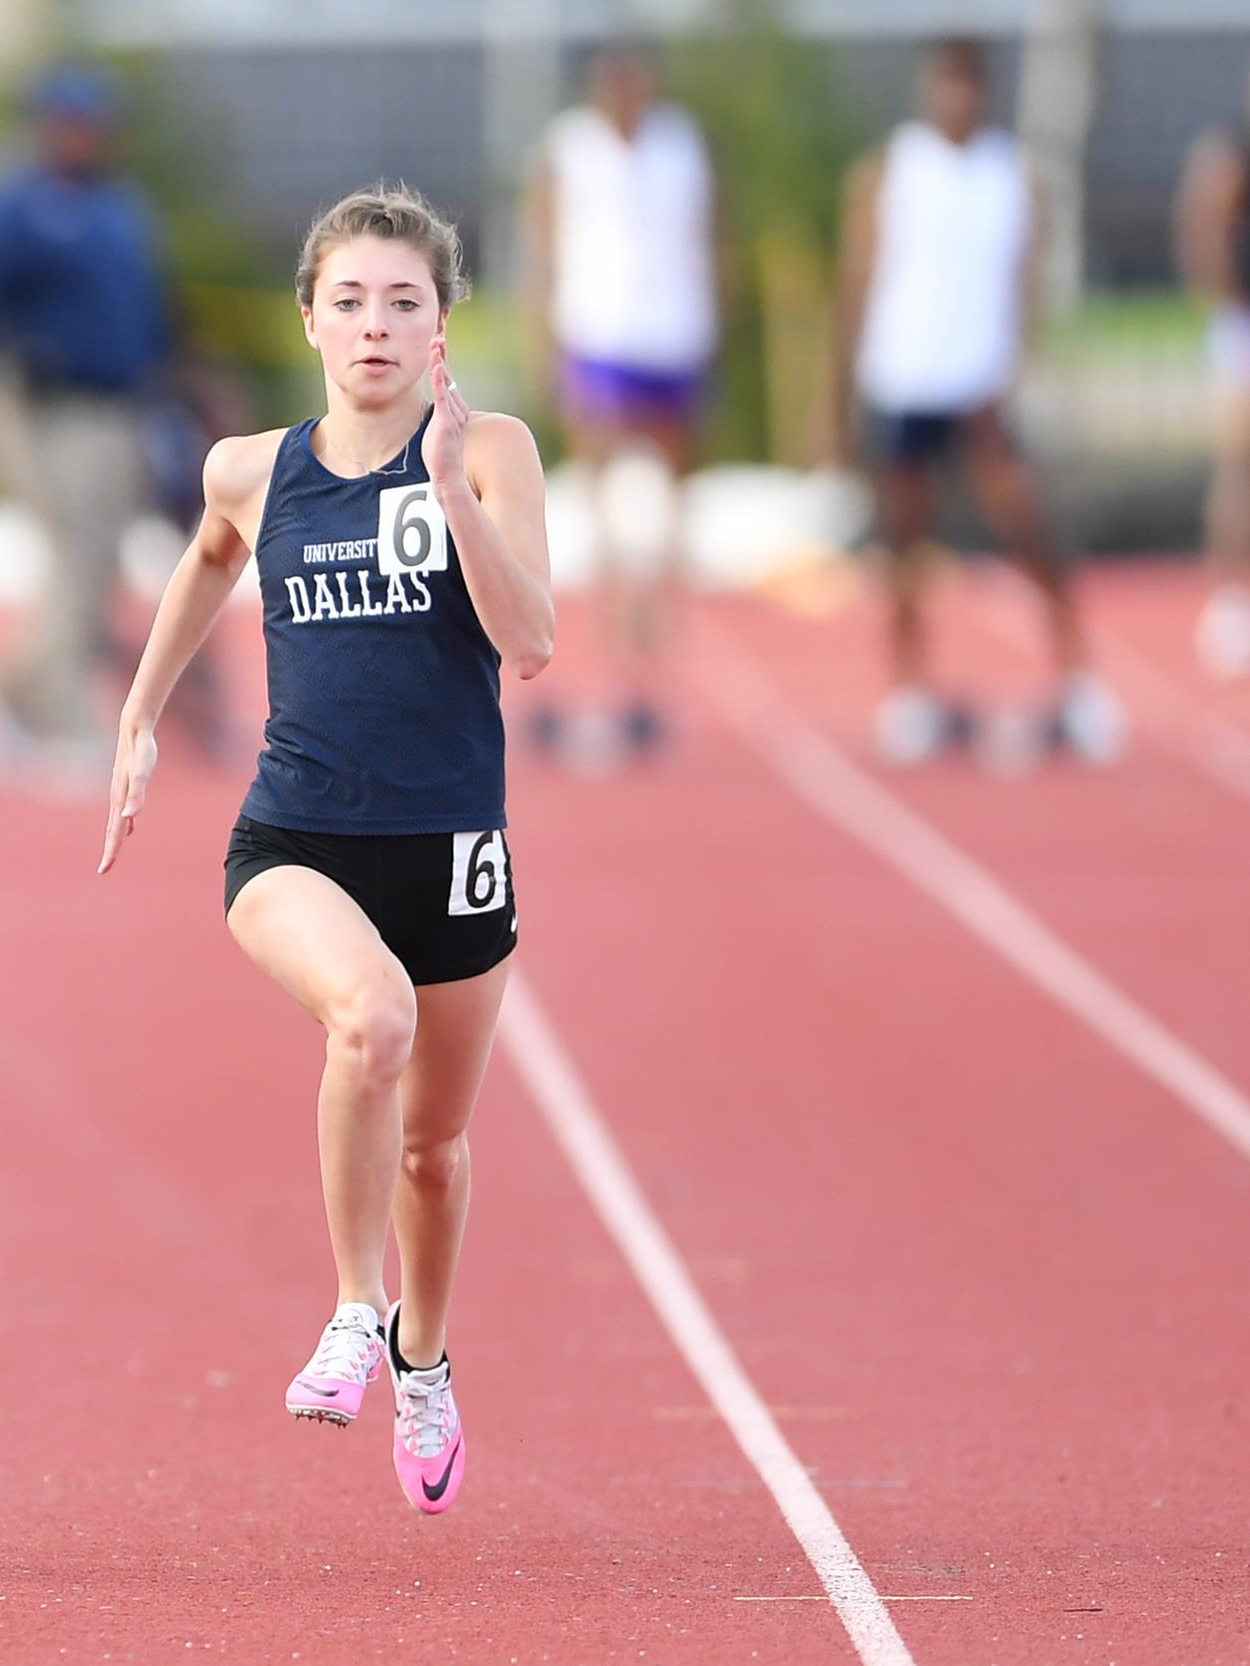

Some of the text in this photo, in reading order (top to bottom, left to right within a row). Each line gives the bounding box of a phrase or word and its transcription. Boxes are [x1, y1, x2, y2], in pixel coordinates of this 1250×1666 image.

[303, 538, 378, 563] UNIVERSIT
[393, 489, 431, 567] 6
[284, 569, 431, 624] DALLAS
[465, 830, 497, 908] 6
